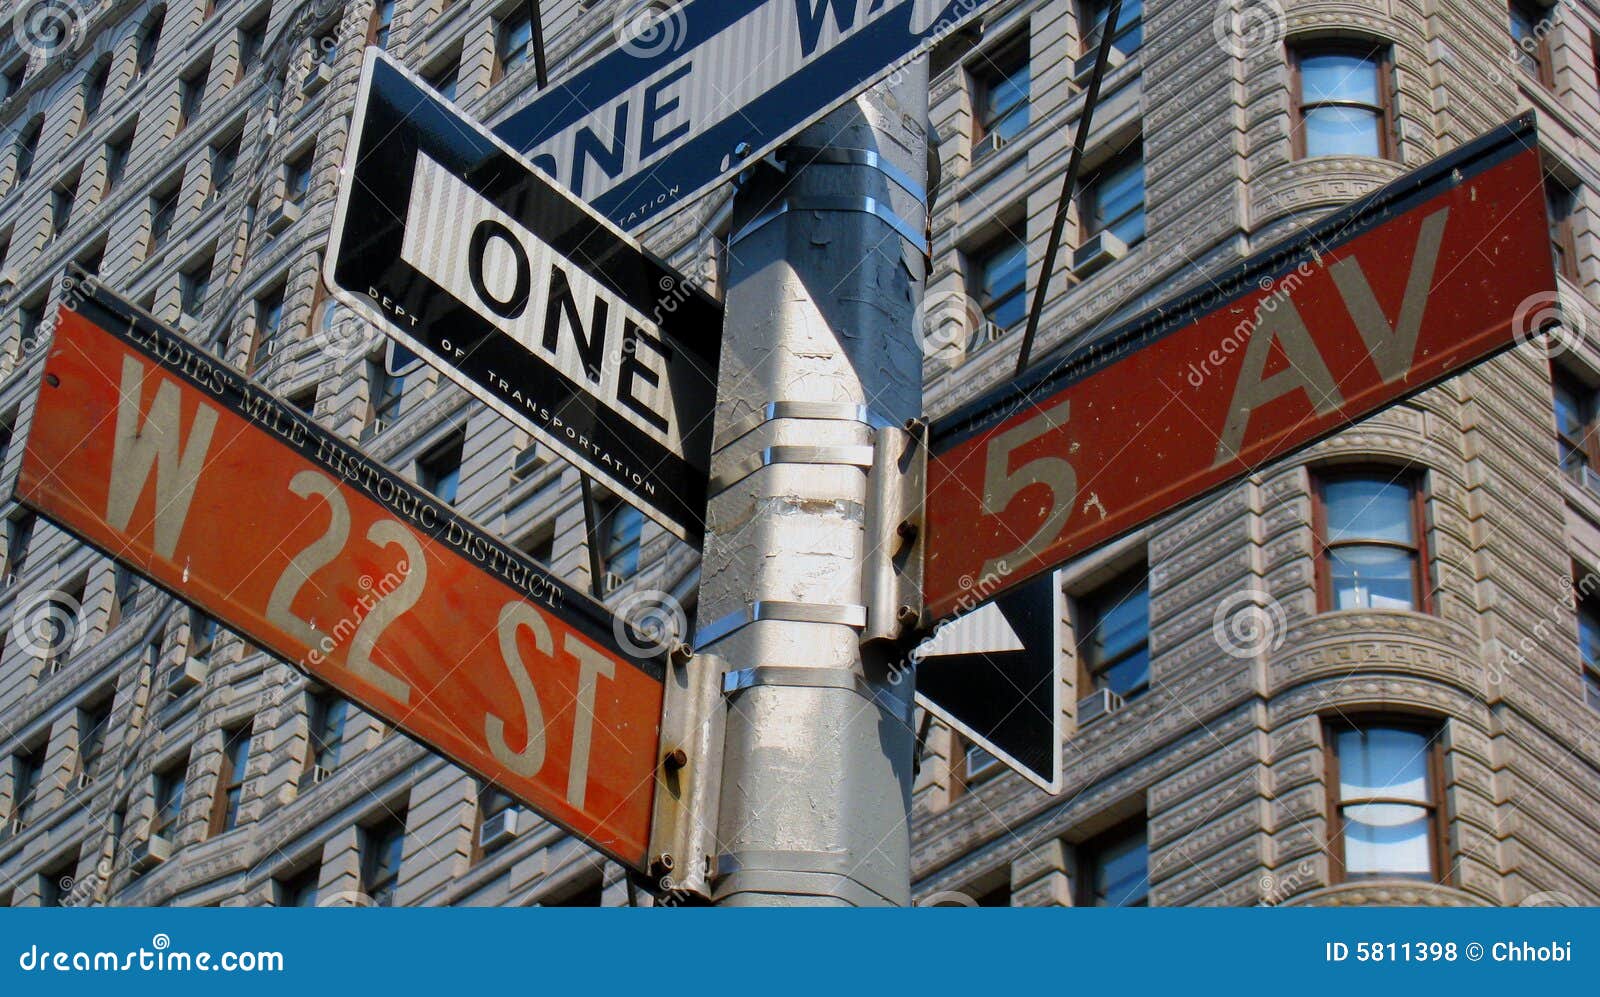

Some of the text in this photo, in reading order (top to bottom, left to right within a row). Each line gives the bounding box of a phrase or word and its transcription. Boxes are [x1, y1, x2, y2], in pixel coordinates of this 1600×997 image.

[368, 286, 656, 496] DEPT OF TRANSPORTATION
[468, 219, 673, 435] ONE
[978, 206, 1449, 583] 5 AV
[106, 353, 615, 811] W 22 ST
[238, 387, 308, 447] MILE
[315, 437, 437, 528] HISTORIC
[446, 519, 563, 609] DISTRICT
